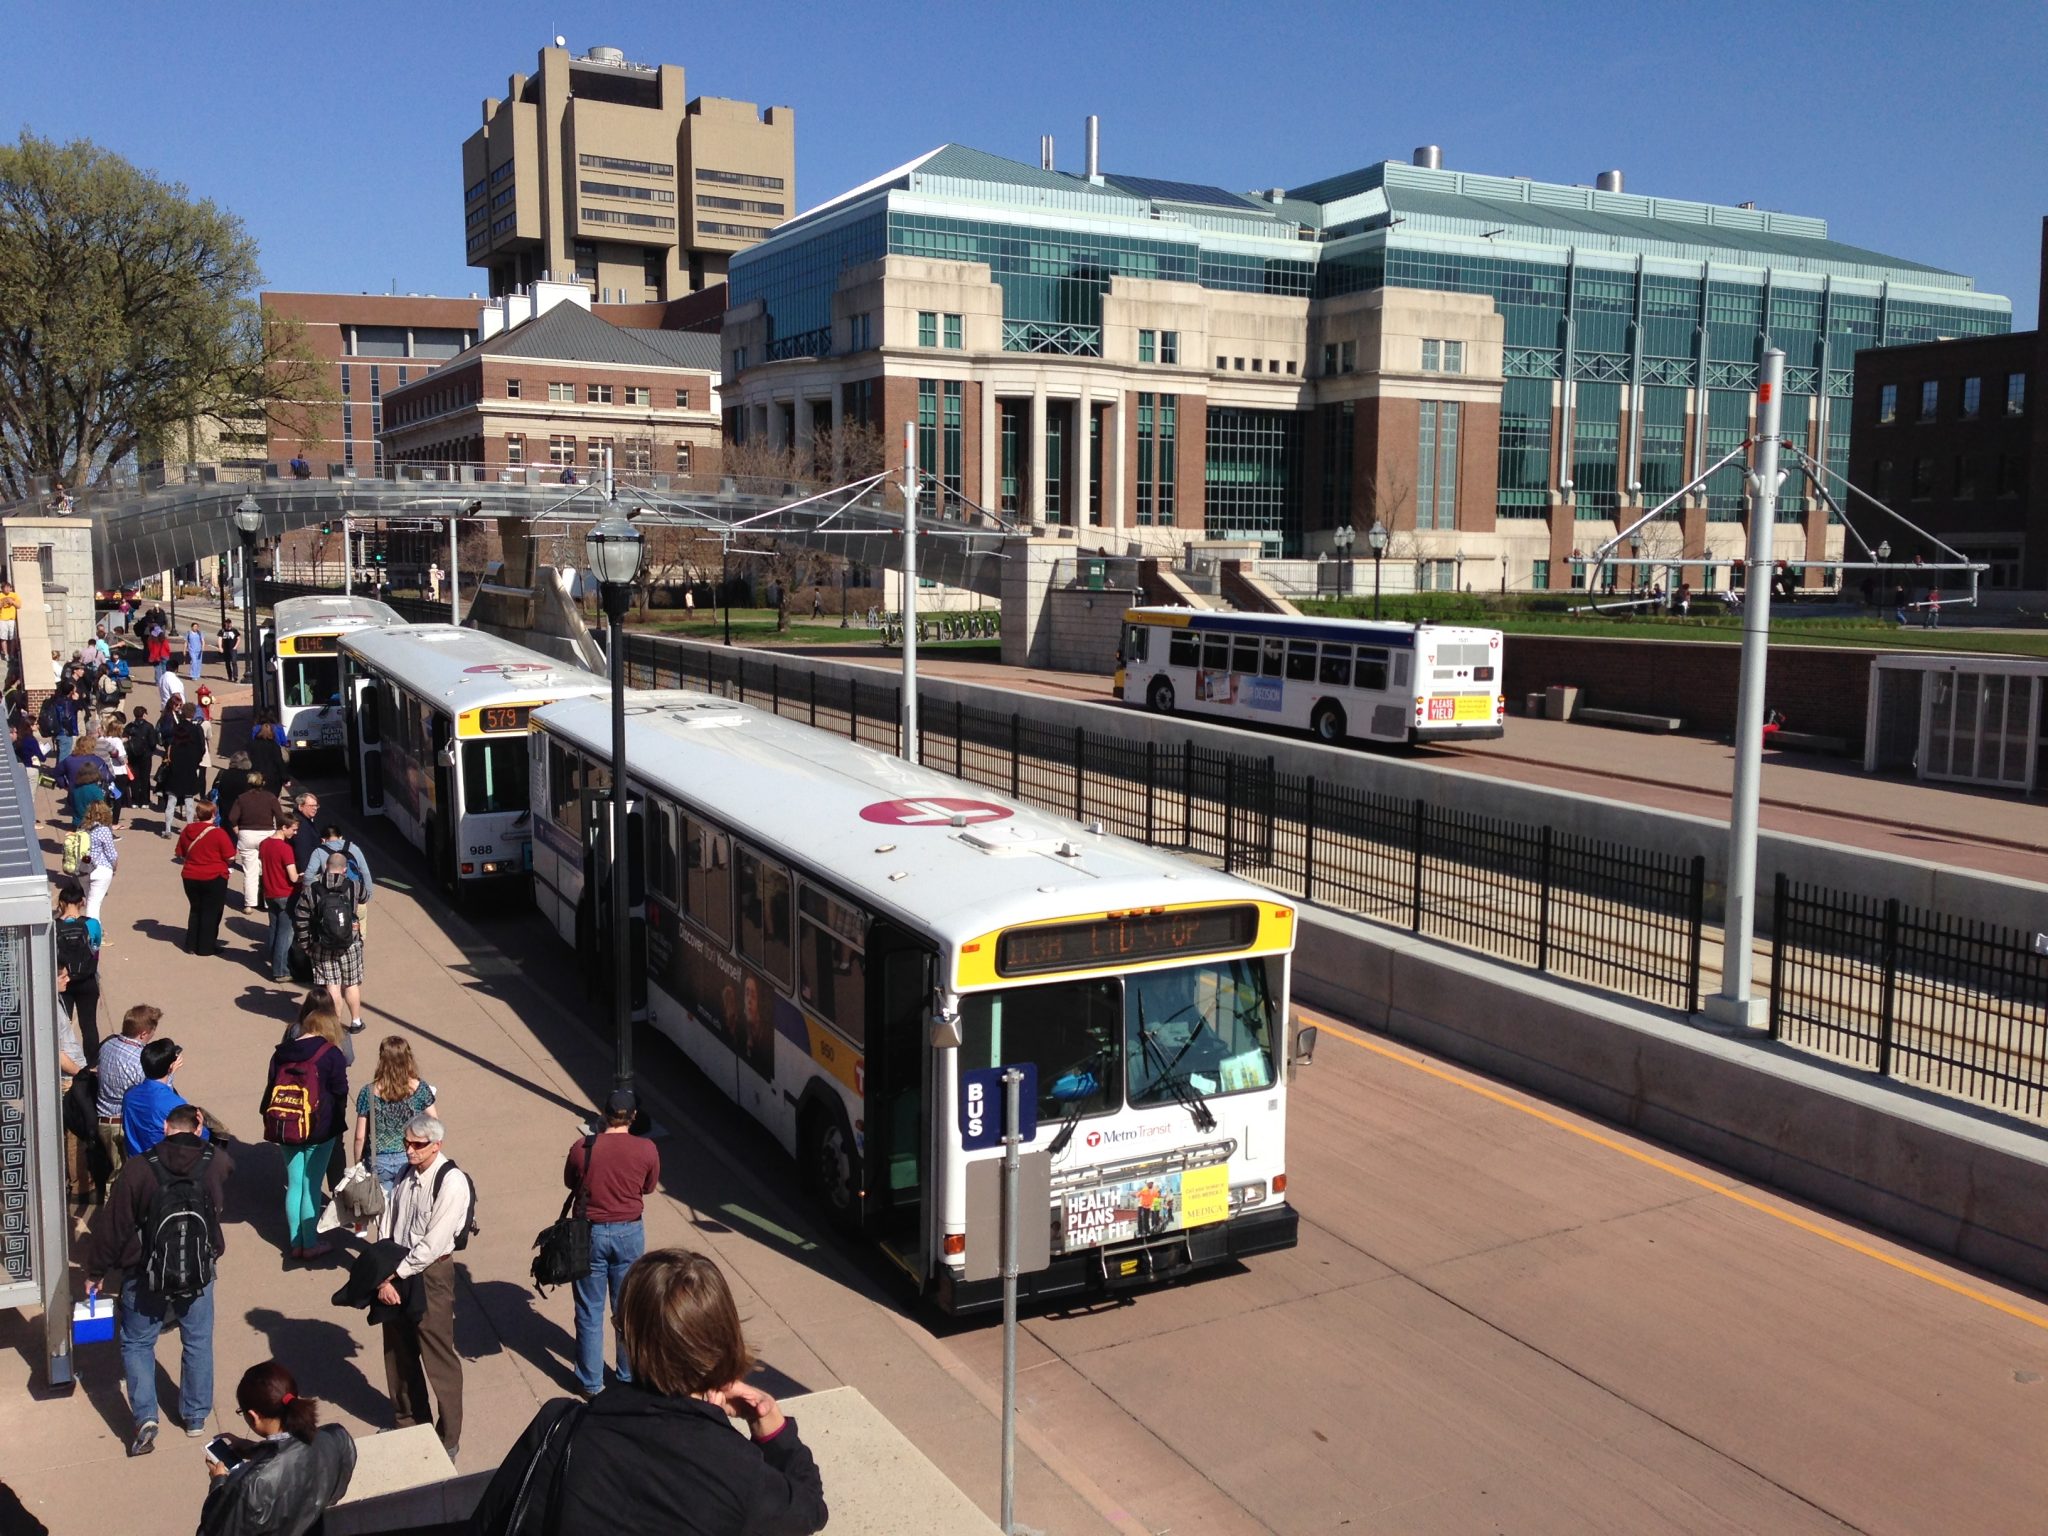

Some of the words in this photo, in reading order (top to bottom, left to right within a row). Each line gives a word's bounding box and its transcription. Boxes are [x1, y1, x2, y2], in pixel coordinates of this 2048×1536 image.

[299, 637, 324, 651] 114C
[1431, 699, 1454, 708] PLEASE
[487, 709, 516, 728] 579
[1431, 708, 1454, 720] YIELD
[470, 845, 493, 856] 988
[717, 953, 742, 984] Yourself
[967, 1082, 984, 1137] BUS
[1068, 1189, 1121, 1214] HEALTH
[1187, 1205, 1223, 1217] MEDICA
[1068, 1207, 1114, 1231] PLANS
[1067, 1225, 1105, 1246] THAT
[1108, 1220, 1132, 1239] FIT.
